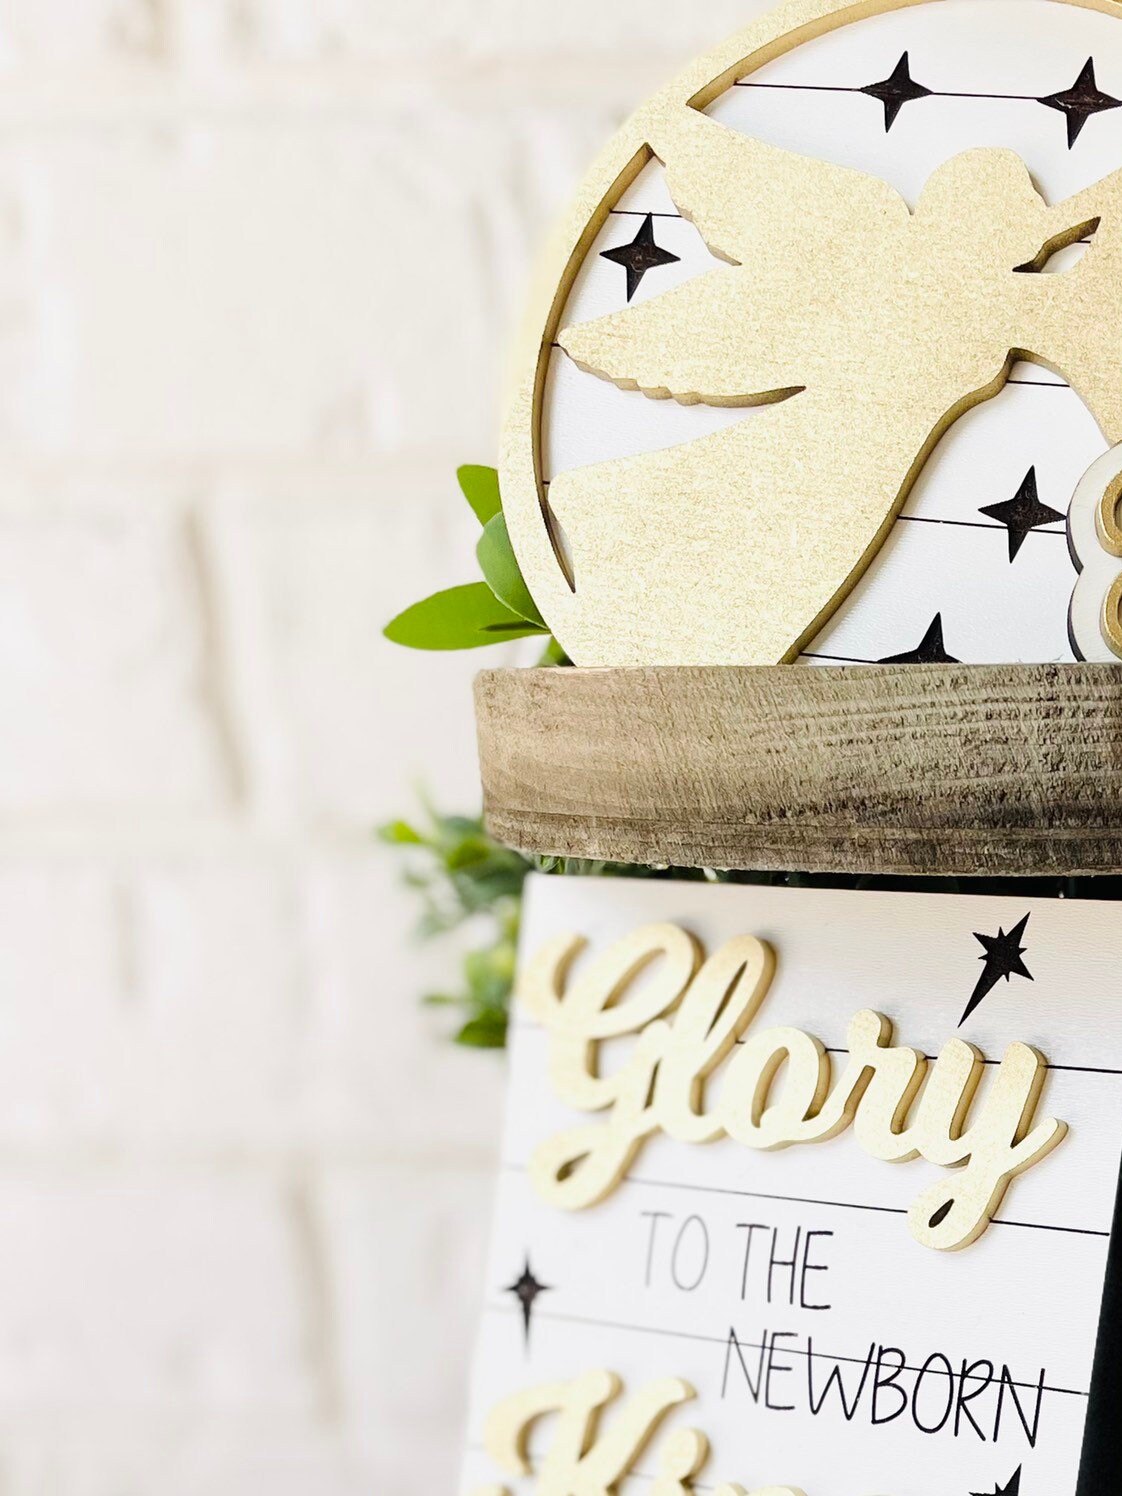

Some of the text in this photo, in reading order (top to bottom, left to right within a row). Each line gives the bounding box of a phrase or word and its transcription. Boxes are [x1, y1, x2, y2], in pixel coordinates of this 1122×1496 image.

[517, 922, 1068, 1251] Glory
[641, 1211, 834, 1311] TO THE
[721, 1326, 1046, 1448] NEWBORN
